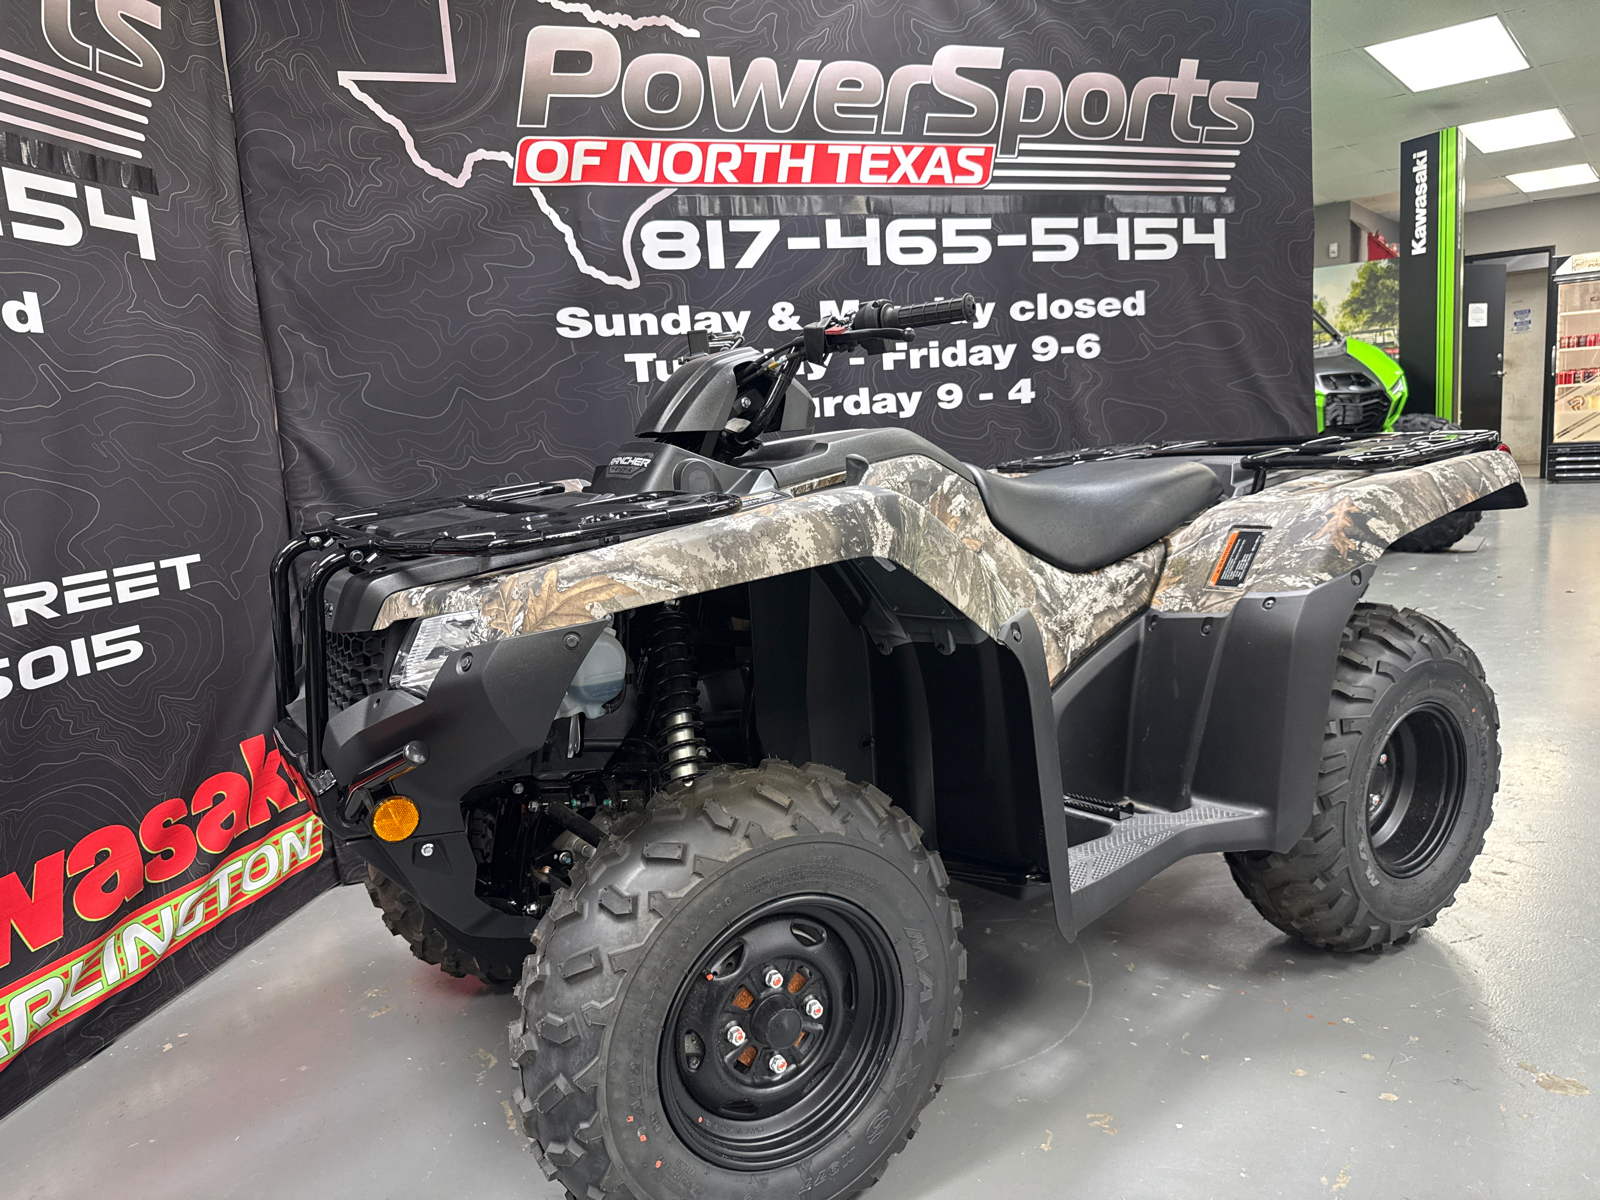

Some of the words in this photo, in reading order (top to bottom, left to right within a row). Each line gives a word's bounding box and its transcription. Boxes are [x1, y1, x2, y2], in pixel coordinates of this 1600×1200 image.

[517, 25, 1259, 158] PowerSports
[525, 141, 607, 181] OF
[618, 142, 815, 183] NORTH
[828, 145, 986, 184] TEXAS
[1411, 150, 1428, 255] Kawasaki
[640, 217, 1226, 270] 817-465-5454
[556, 305, 751, 338] Sunday
[1009, 290, 1146, 322] closed
[882, 340, 1017, 370] Friday
[1031, 333, 1101, 362] 9-6
[3, 553, 201, 627] REET
[0, 625, 144, 700] 015
[0, 818, 314, 1060] RLINGTON
